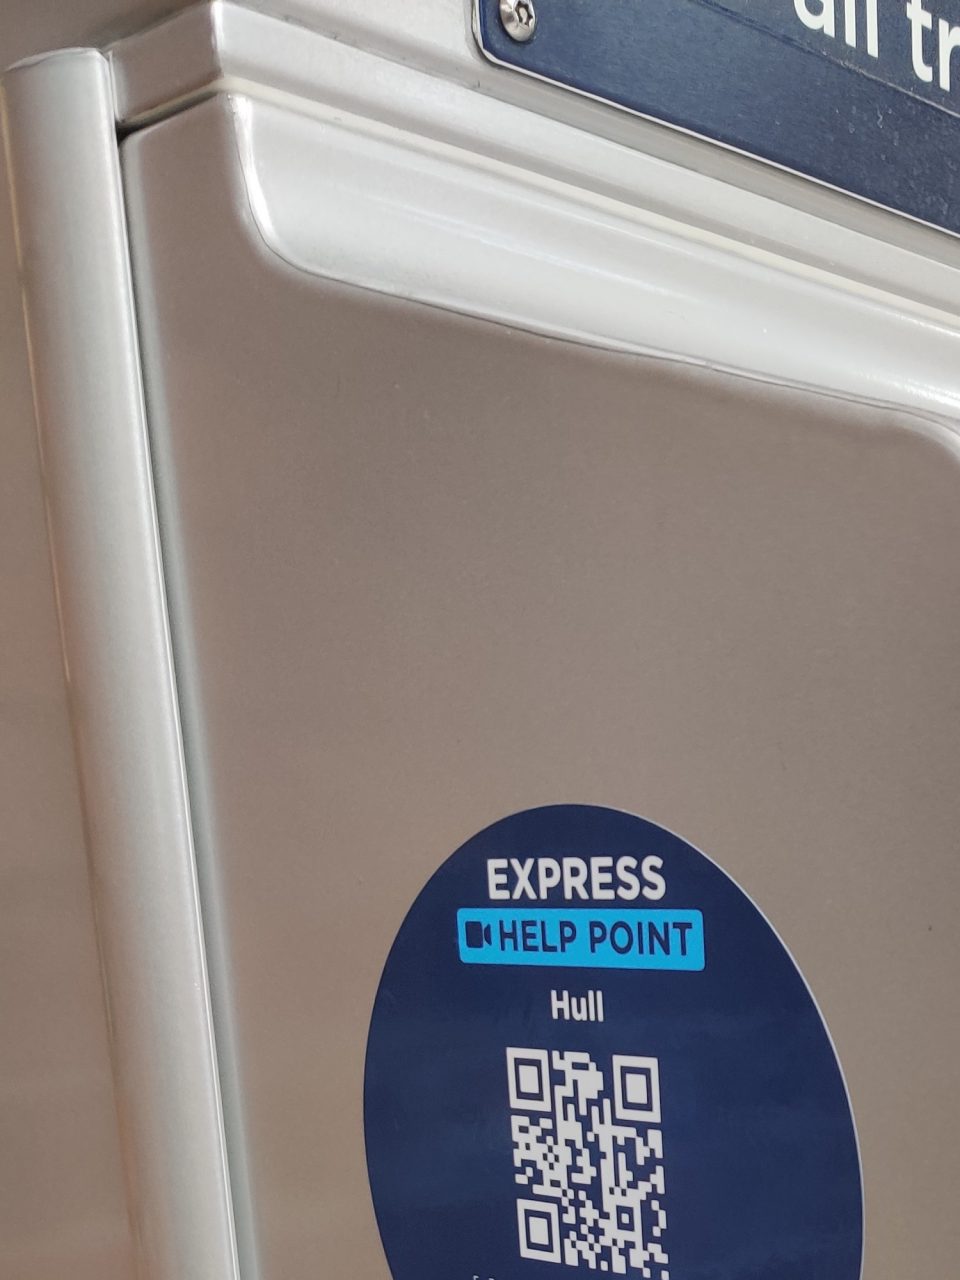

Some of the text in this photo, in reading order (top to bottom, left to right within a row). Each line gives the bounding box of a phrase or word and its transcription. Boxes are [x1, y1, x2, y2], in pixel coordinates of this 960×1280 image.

[486, 855, 667, 901] EXPRESS
[499, 919, 693, 956] HELP POINT
[550, 989, 604, 1022] Hull
